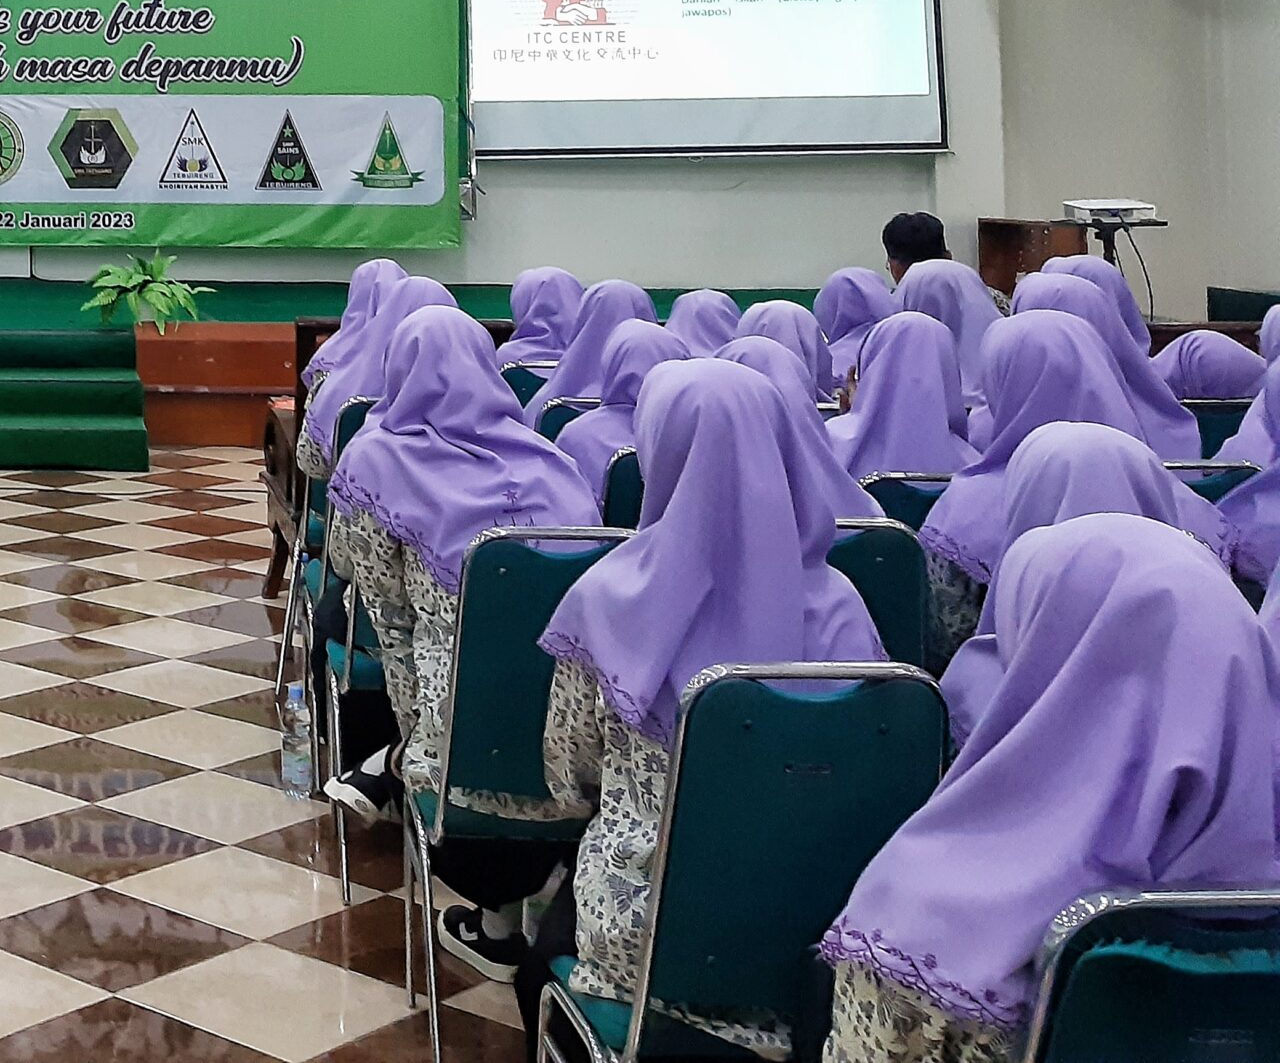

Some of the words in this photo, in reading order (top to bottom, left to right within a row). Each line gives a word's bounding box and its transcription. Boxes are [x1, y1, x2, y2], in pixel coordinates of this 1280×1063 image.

[18, 6, 103, 45] your
[527, 32, 553, 44] ITC
[559, 30, 627, 43] CENTRE
[12, 57, 115, 83] masa
[121, 36, 305, 92] depanmu)
[181, 137, 204, 147] SMK
[277, 147, 300, 155] SAINS
[20, 212, 85, 229] Januari
[91, 212, 134, 228] 2023
